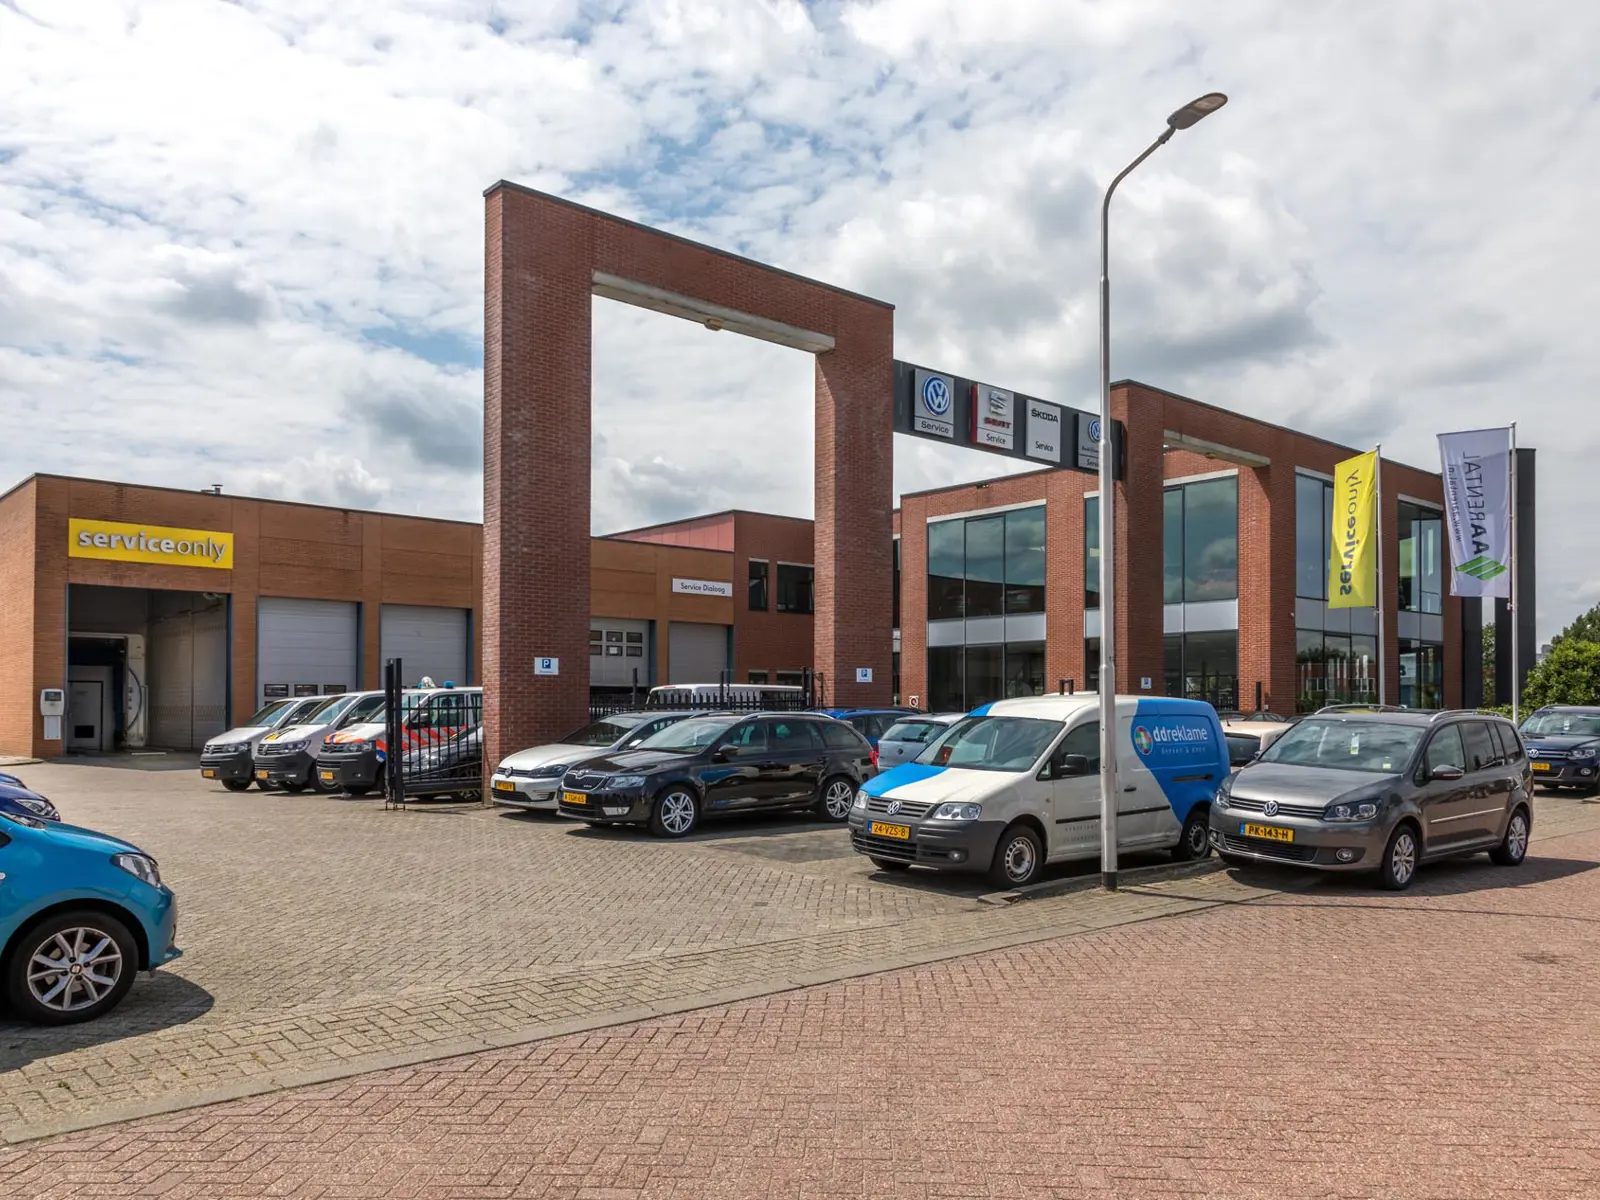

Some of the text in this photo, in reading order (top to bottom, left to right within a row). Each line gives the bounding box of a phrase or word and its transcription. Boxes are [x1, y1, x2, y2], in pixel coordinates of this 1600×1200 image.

[1031, 407, 1059, 424] ŠKODA
[921, 420, 949, 434] Service
[986, 433, 1006, 445] Service
[1035, 440, 1054, 453] Service
[78, 531, 227, 563] serviceonly
[681, 582, 701, 591] Service
[1153, 724, 1208, 742] ddreklame
[874, 823, 906, 837] 24-VZS-8
[1248, 825, 1289, 840] PK-143-H
